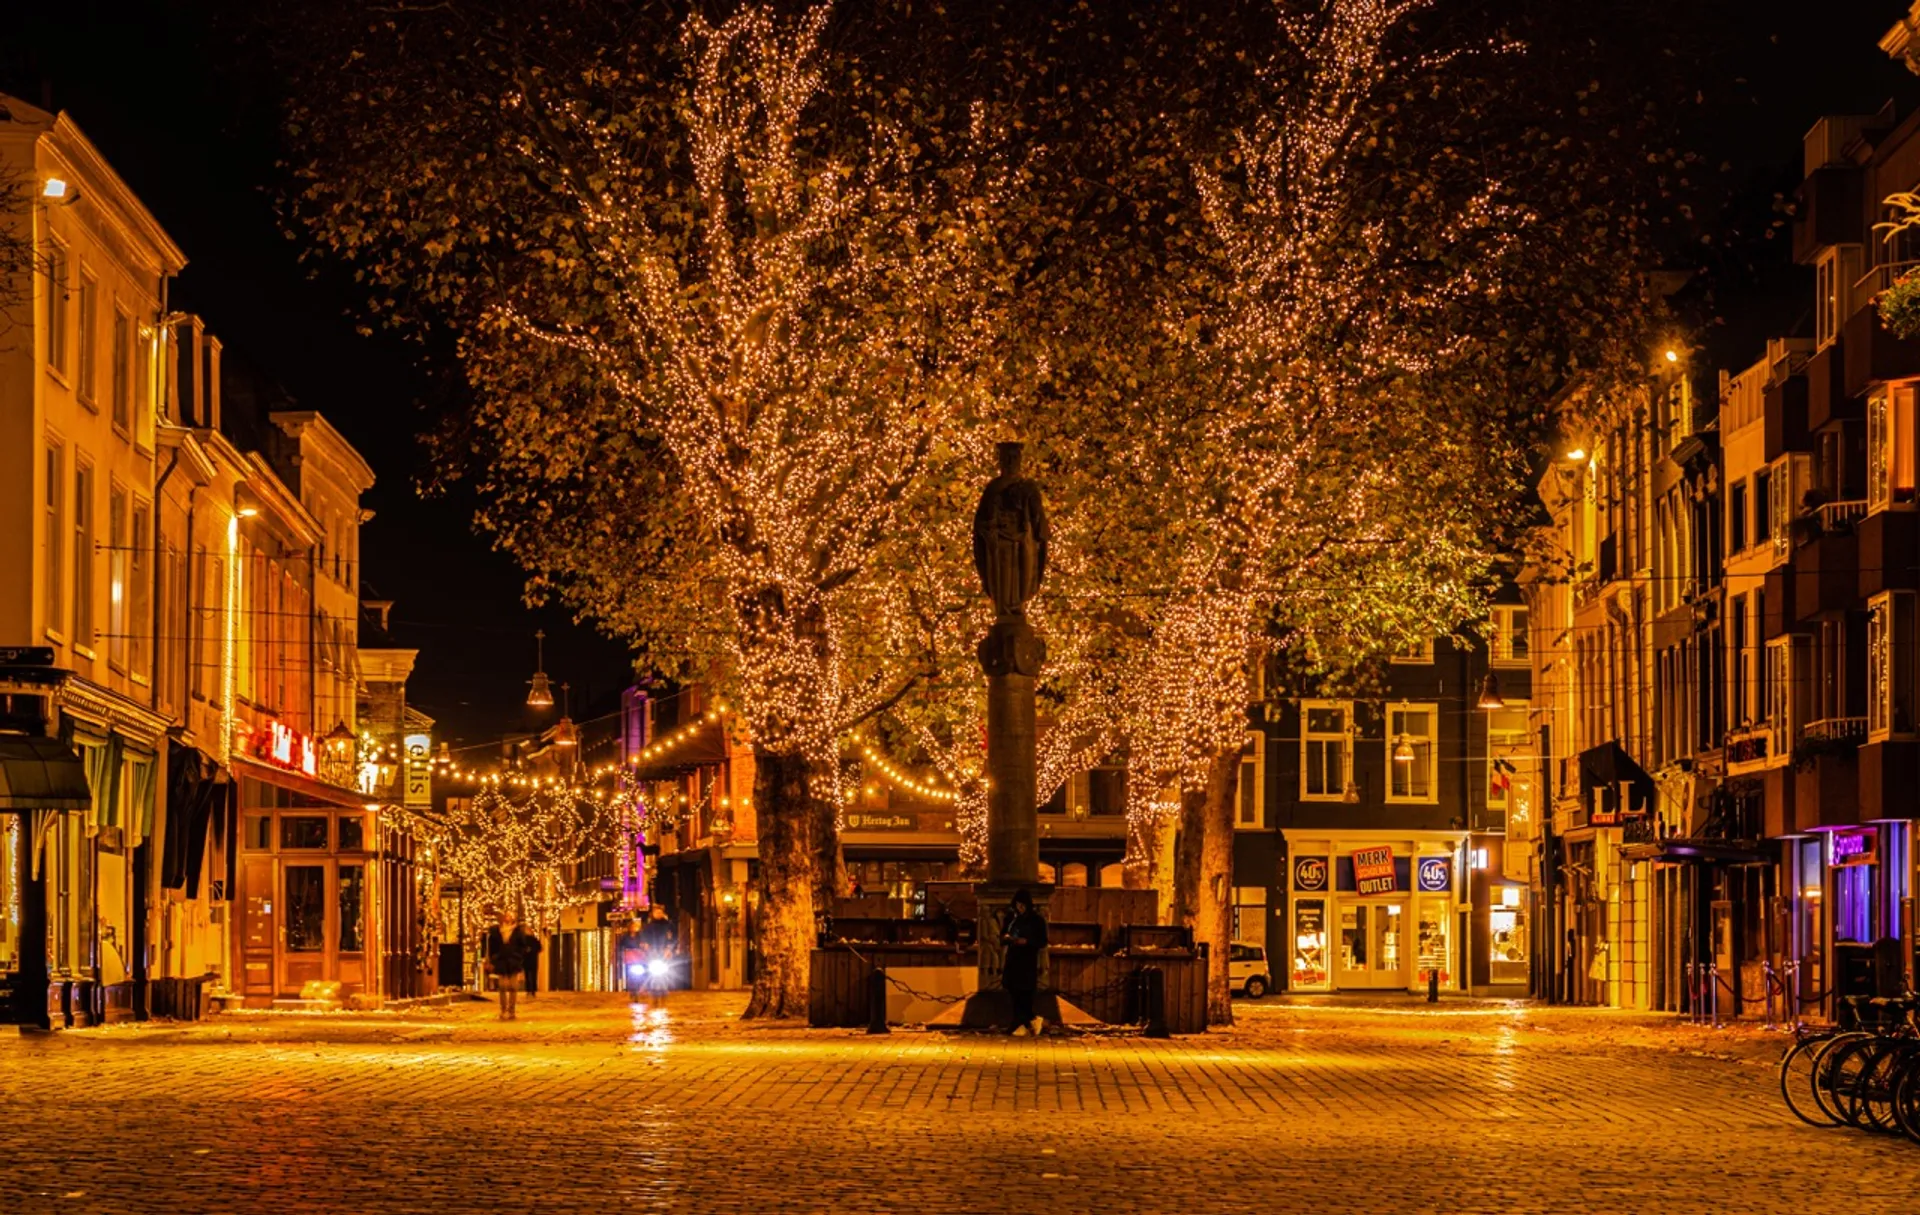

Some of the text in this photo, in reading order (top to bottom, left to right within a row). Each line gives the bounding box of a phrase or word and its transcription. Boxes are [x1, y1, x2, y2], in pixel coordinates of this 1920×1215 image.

[1357, 849, 1389, 866] MERK
[1423, 866, 1445, 880] 40%
[1359, 876, 1393, 894] OUTLET
